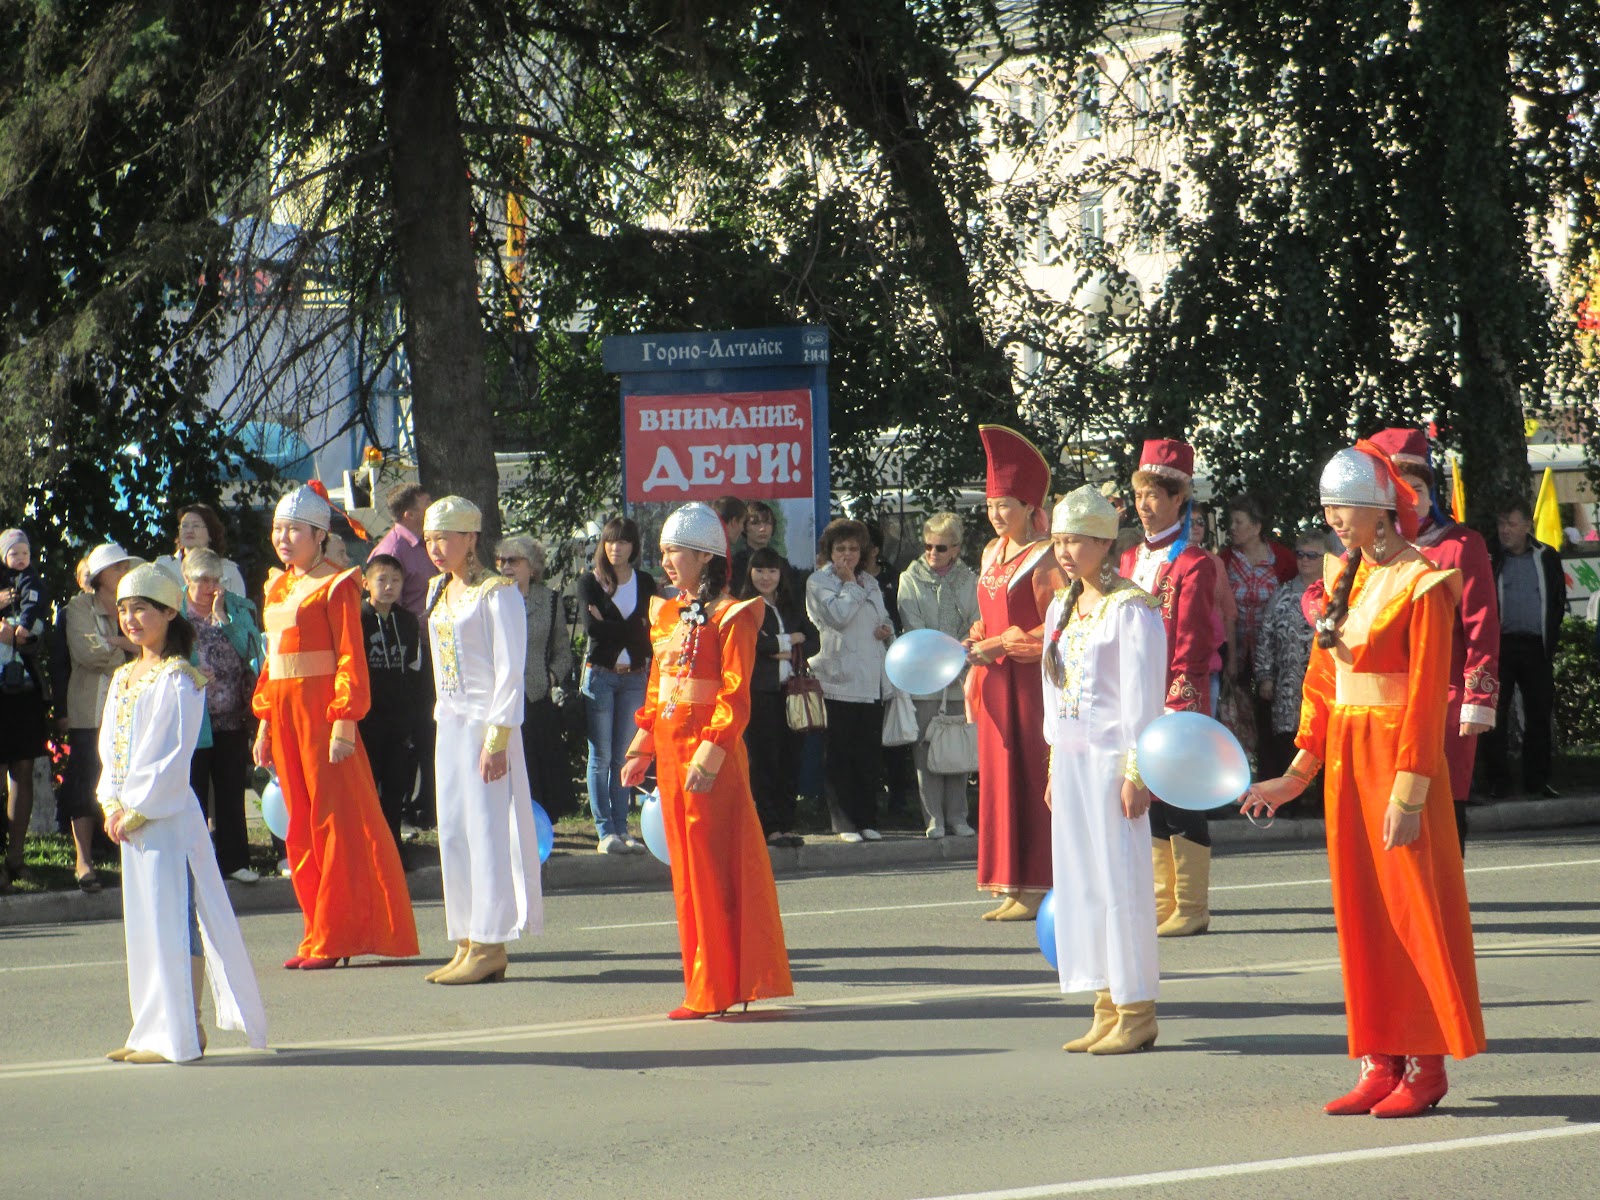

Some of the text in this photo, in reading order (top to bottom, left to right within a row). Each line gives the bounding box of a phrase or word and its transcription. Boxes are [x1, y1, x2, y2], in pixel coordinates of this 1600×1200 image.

[642, 338, 783, 366] Горно-Алтайск
[639, 404, 804, 431] ВНИМАНИЕ,
[642, 442, 802, 493] ДЕТИ!
